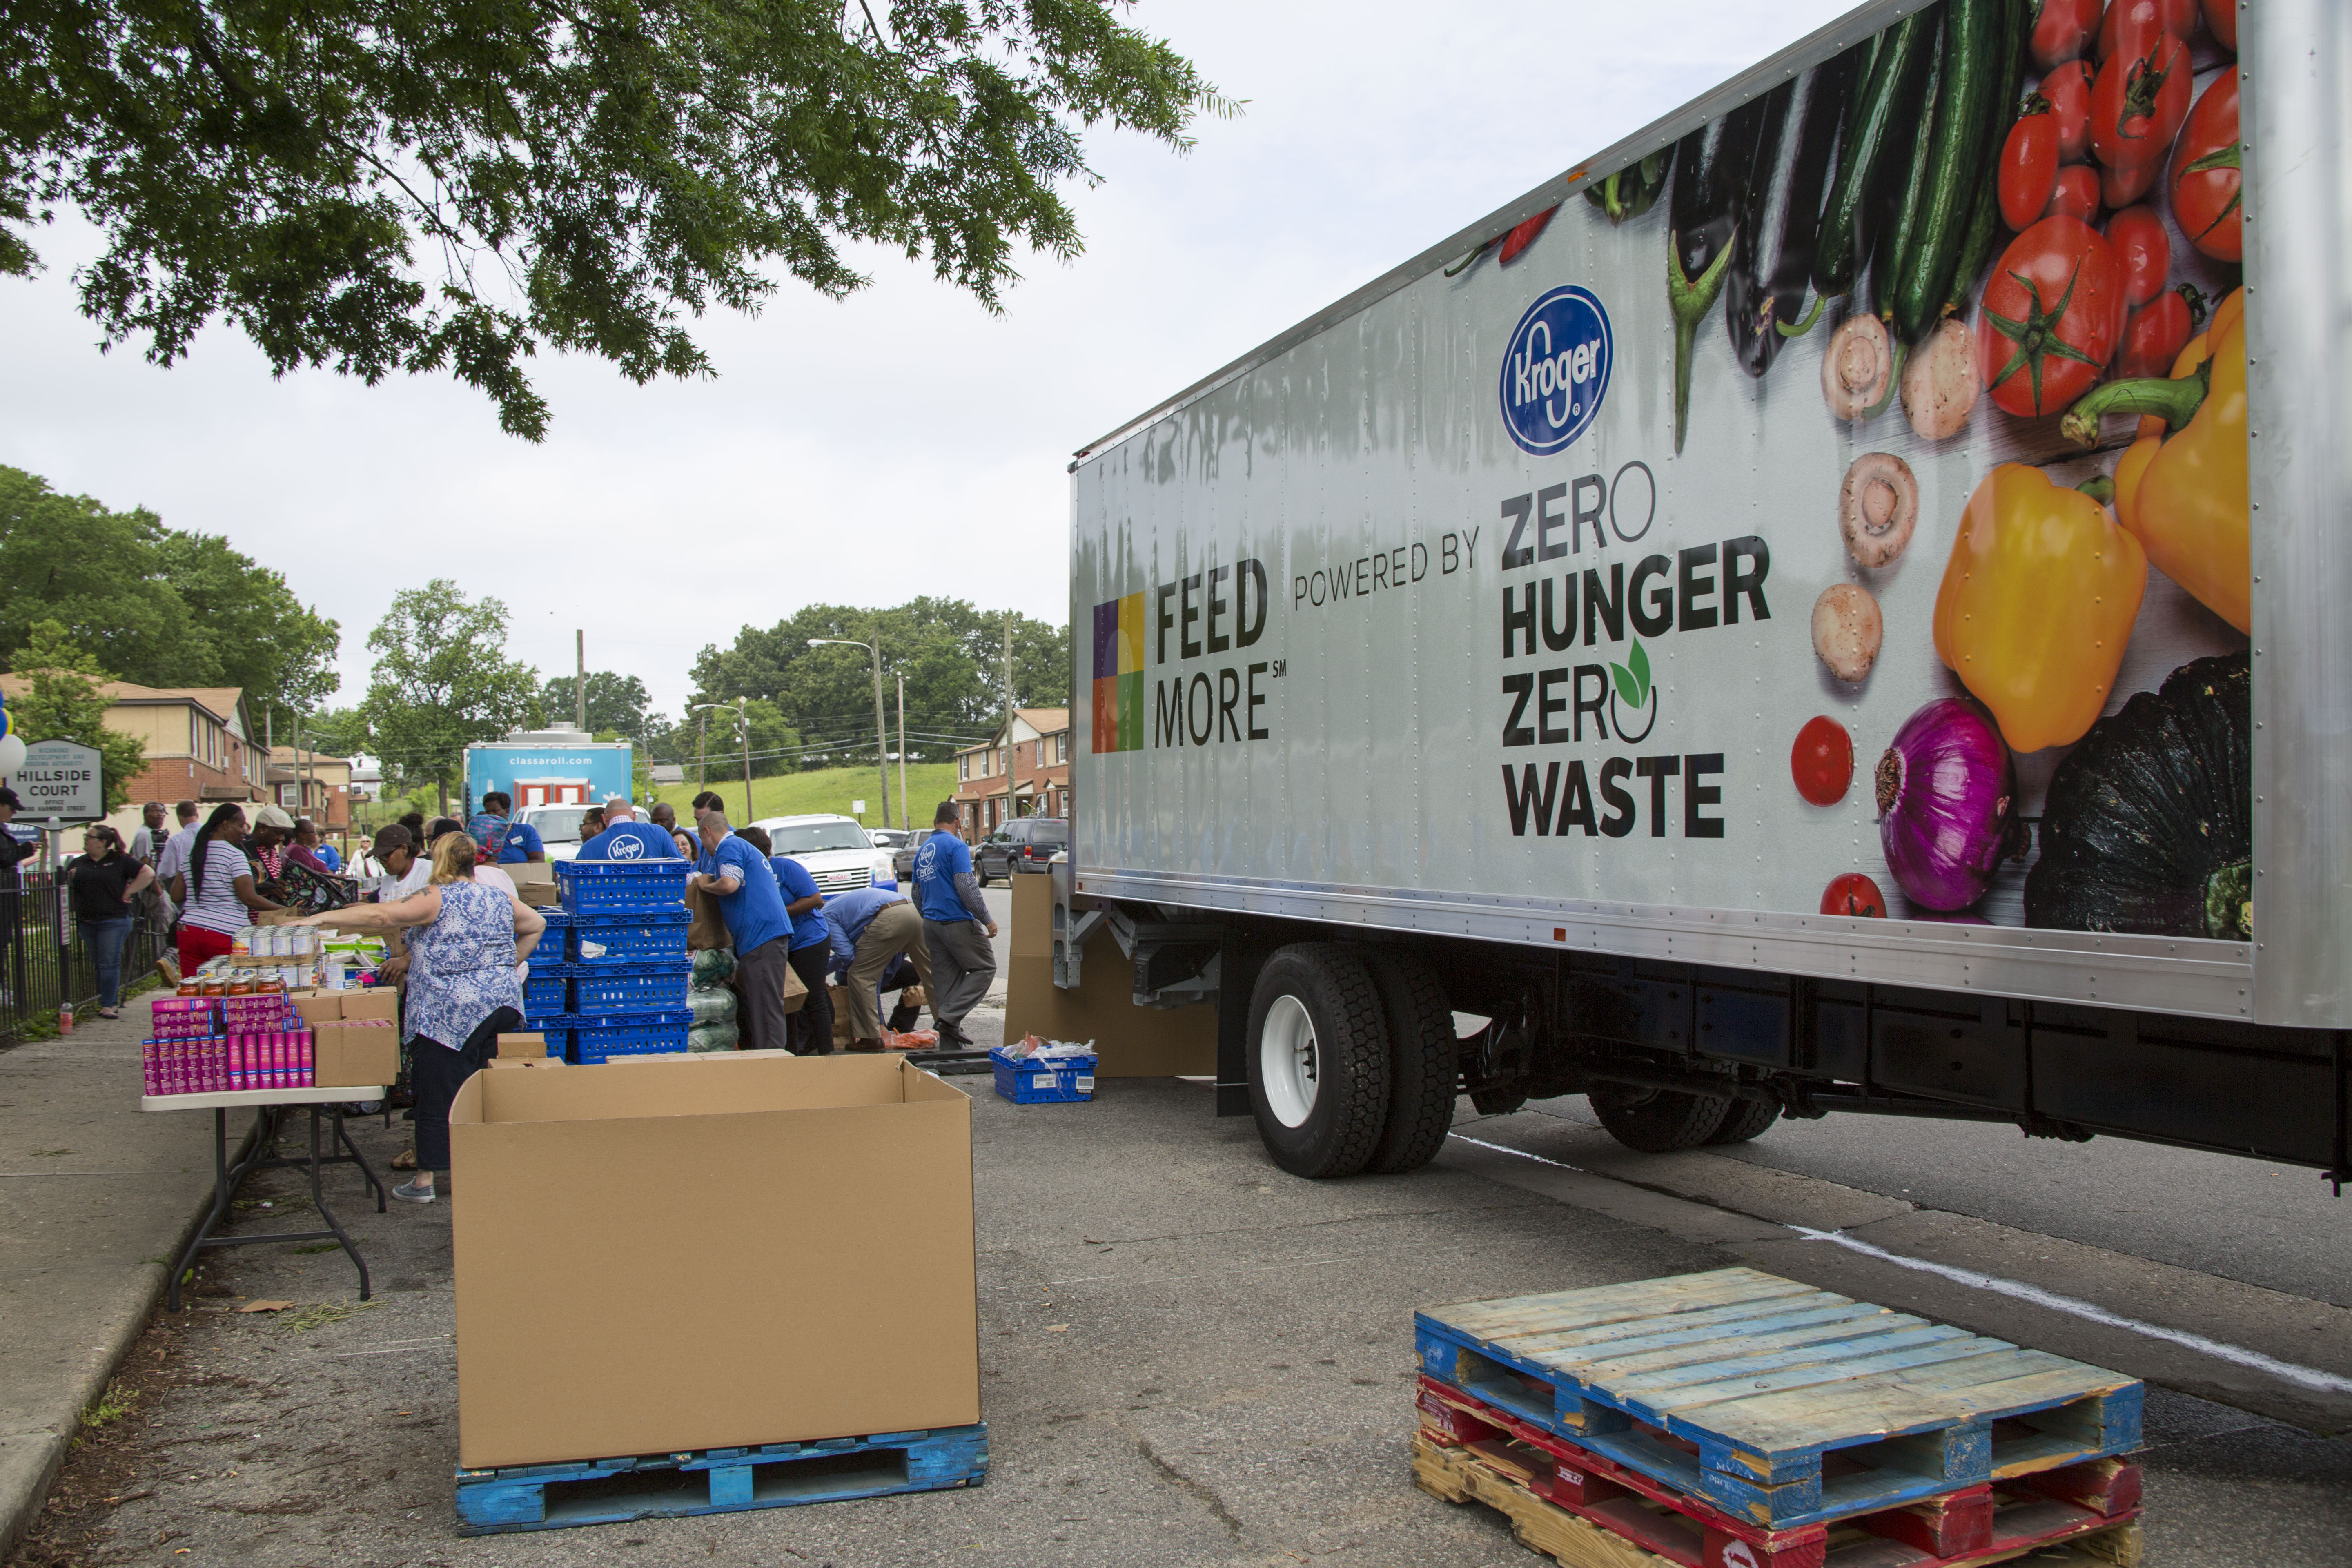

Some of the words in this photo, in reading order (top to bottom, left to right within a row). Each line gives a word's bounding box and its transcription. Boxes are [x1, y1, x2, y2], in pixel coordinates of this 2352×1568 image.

[1515, 321, 1600, 428] Kroger
[1501, 461, 1655, 571] ZERO
[1157, 558, 1268, 664] FEED
[1296, 543, 1427, 611] POWERED
[1442, 526, 1479, 575] BY
[1502, 535, 1771, 659] HUNGER
[1155, 662, 1269, 748] MORE
[1502, 662, 1657, 747] ZERO
[17, 770, 91, 782] HILLSIDE
[29, 785, 79, 796] COURT
[510, 757, 592, 765] classaroll.com
[1501, 753, 1724, 838] WASTE
[612, 840, 640, 859] Kroger
[916, 865, 934, 879] Cares
